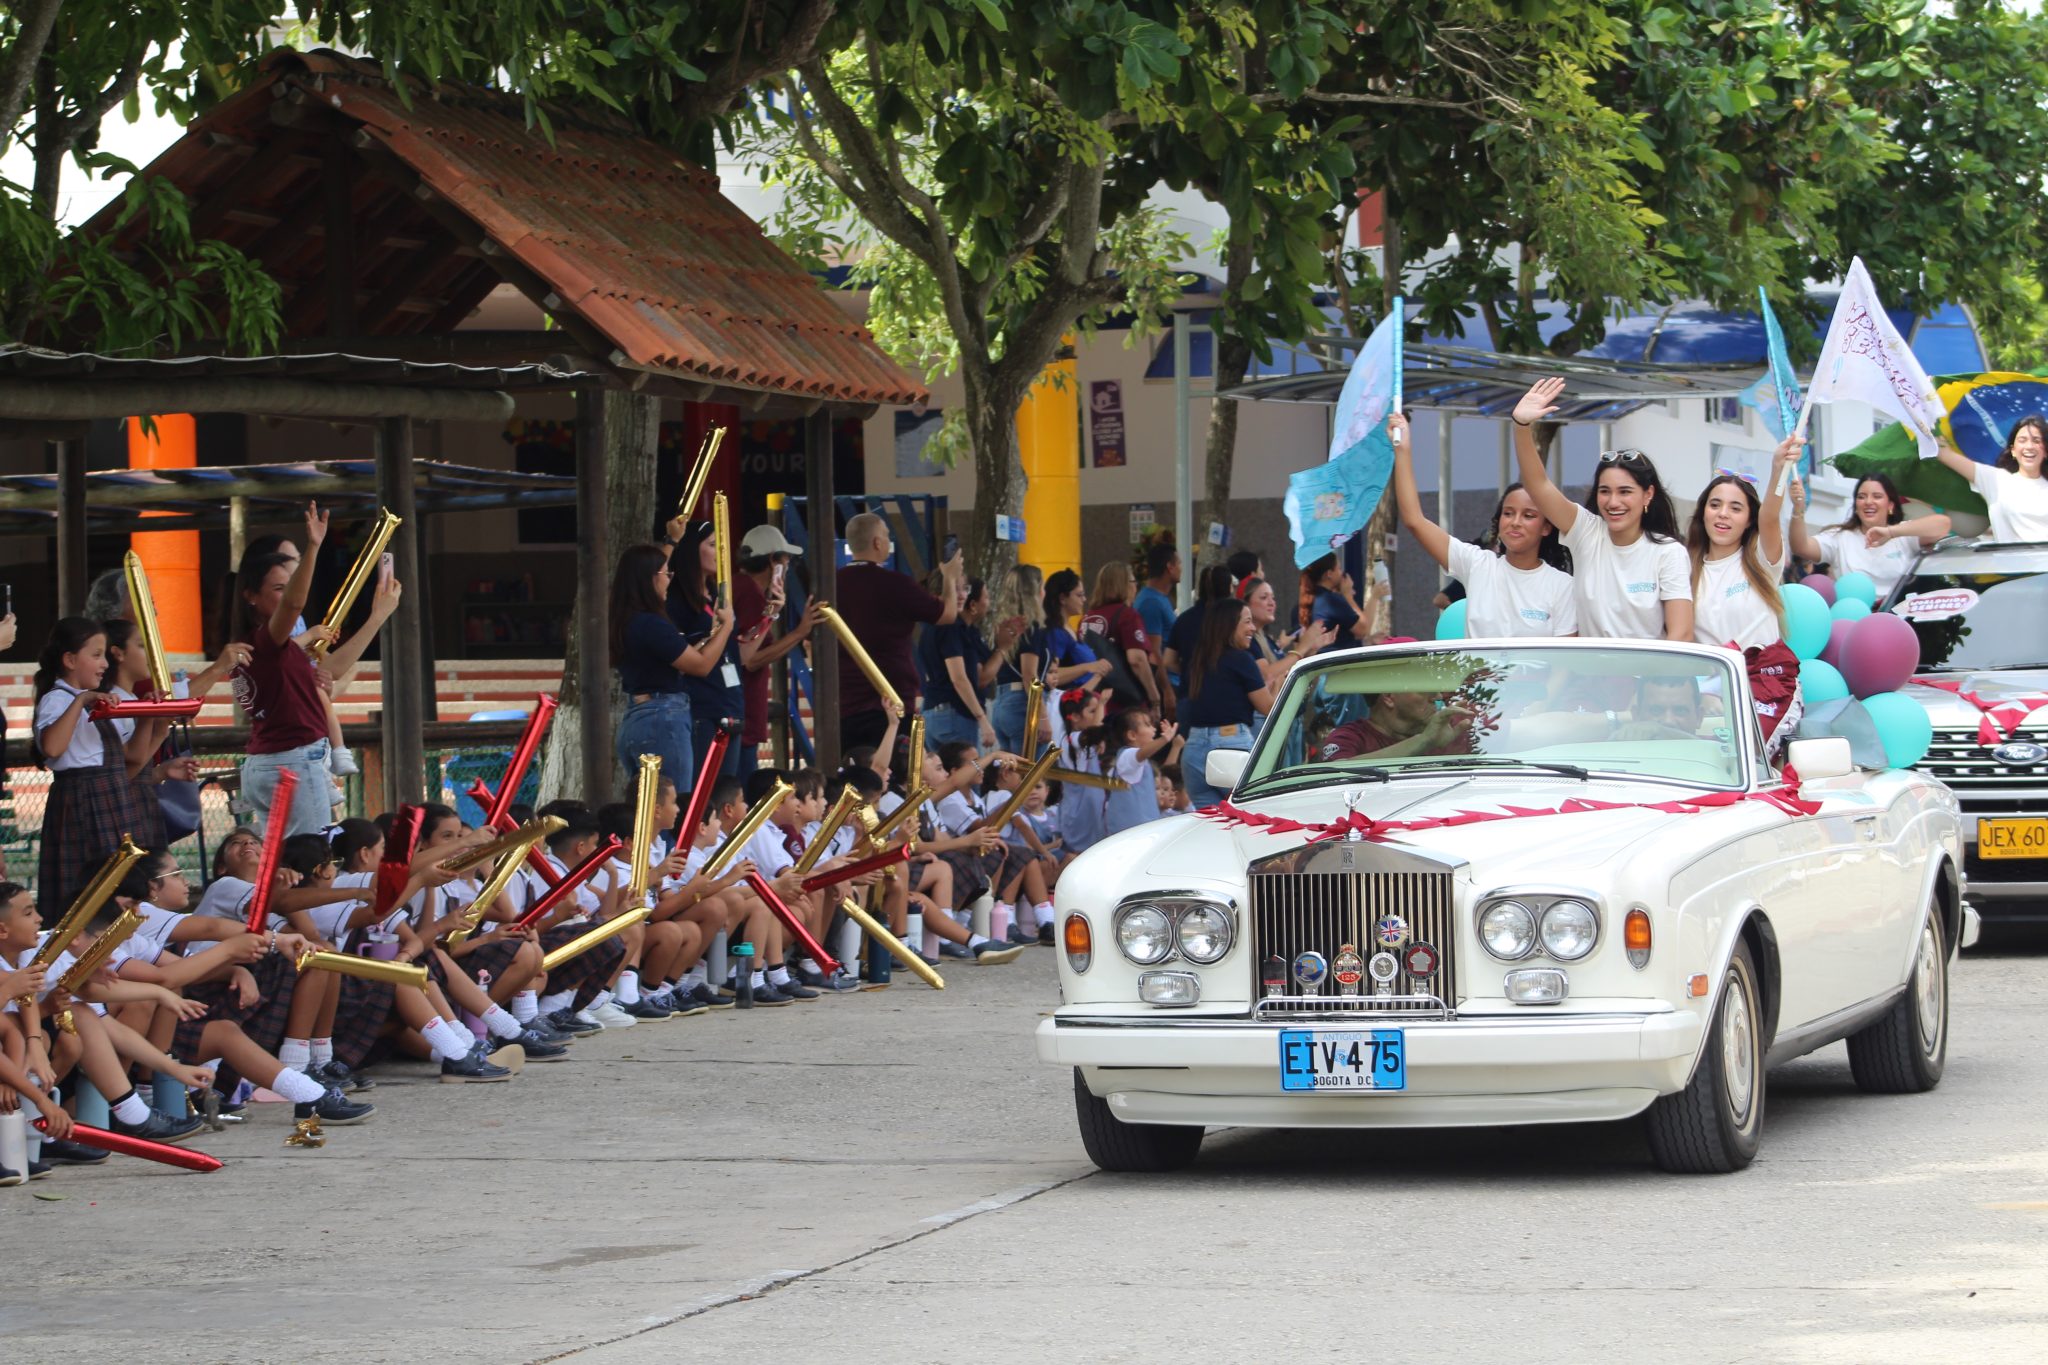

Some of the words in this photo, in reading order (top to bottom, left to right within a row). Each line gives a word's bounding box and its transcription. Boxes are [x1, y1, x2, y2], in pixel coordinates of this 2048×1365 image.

[1910, 596, 1968, 606] WORLDWIDE
[2004, 745, 2034, 759] Ford
[1982, 826, 2016, 847] JEX
[2022, 826, 2048, 847] 60
[1323, 1033, 1362, 1041] ANTIGUO
[1286, 1041, 1337, 1074] EIV
[1347, 1041, 1399, 1073] 475
[1313, 1076, 1351, 1086] BOGOTA
